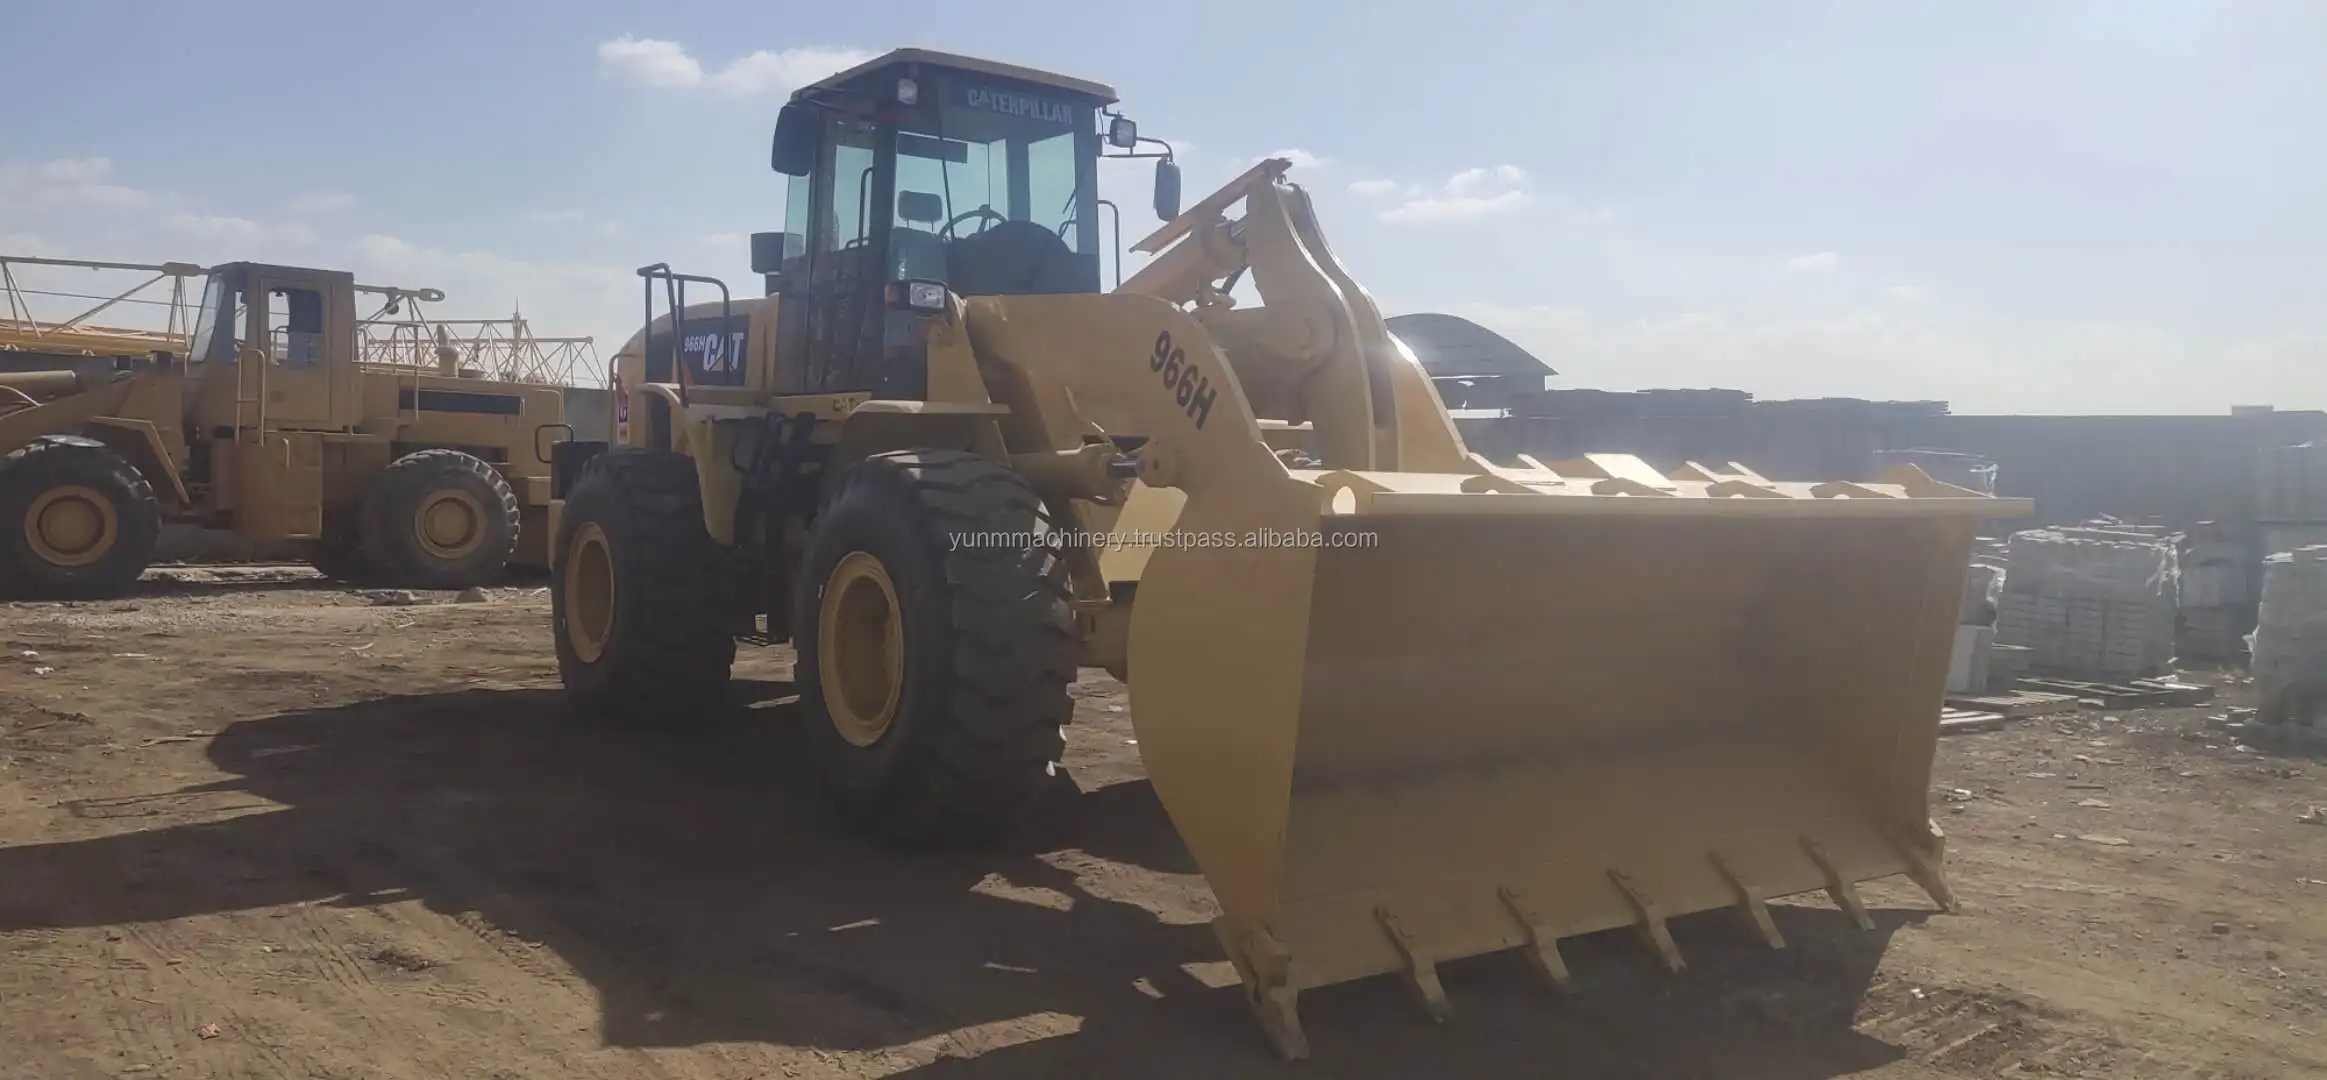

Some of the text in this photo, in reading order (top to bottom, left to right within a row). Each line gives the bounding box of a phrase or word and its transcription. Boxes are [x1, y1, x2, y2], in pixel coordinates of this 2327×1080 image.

[967, 88, 1073, 125] CATERPILLAR
[684, 332, 744, 371] 966H CAT
[1150, 330, 1217, 430] 966H
